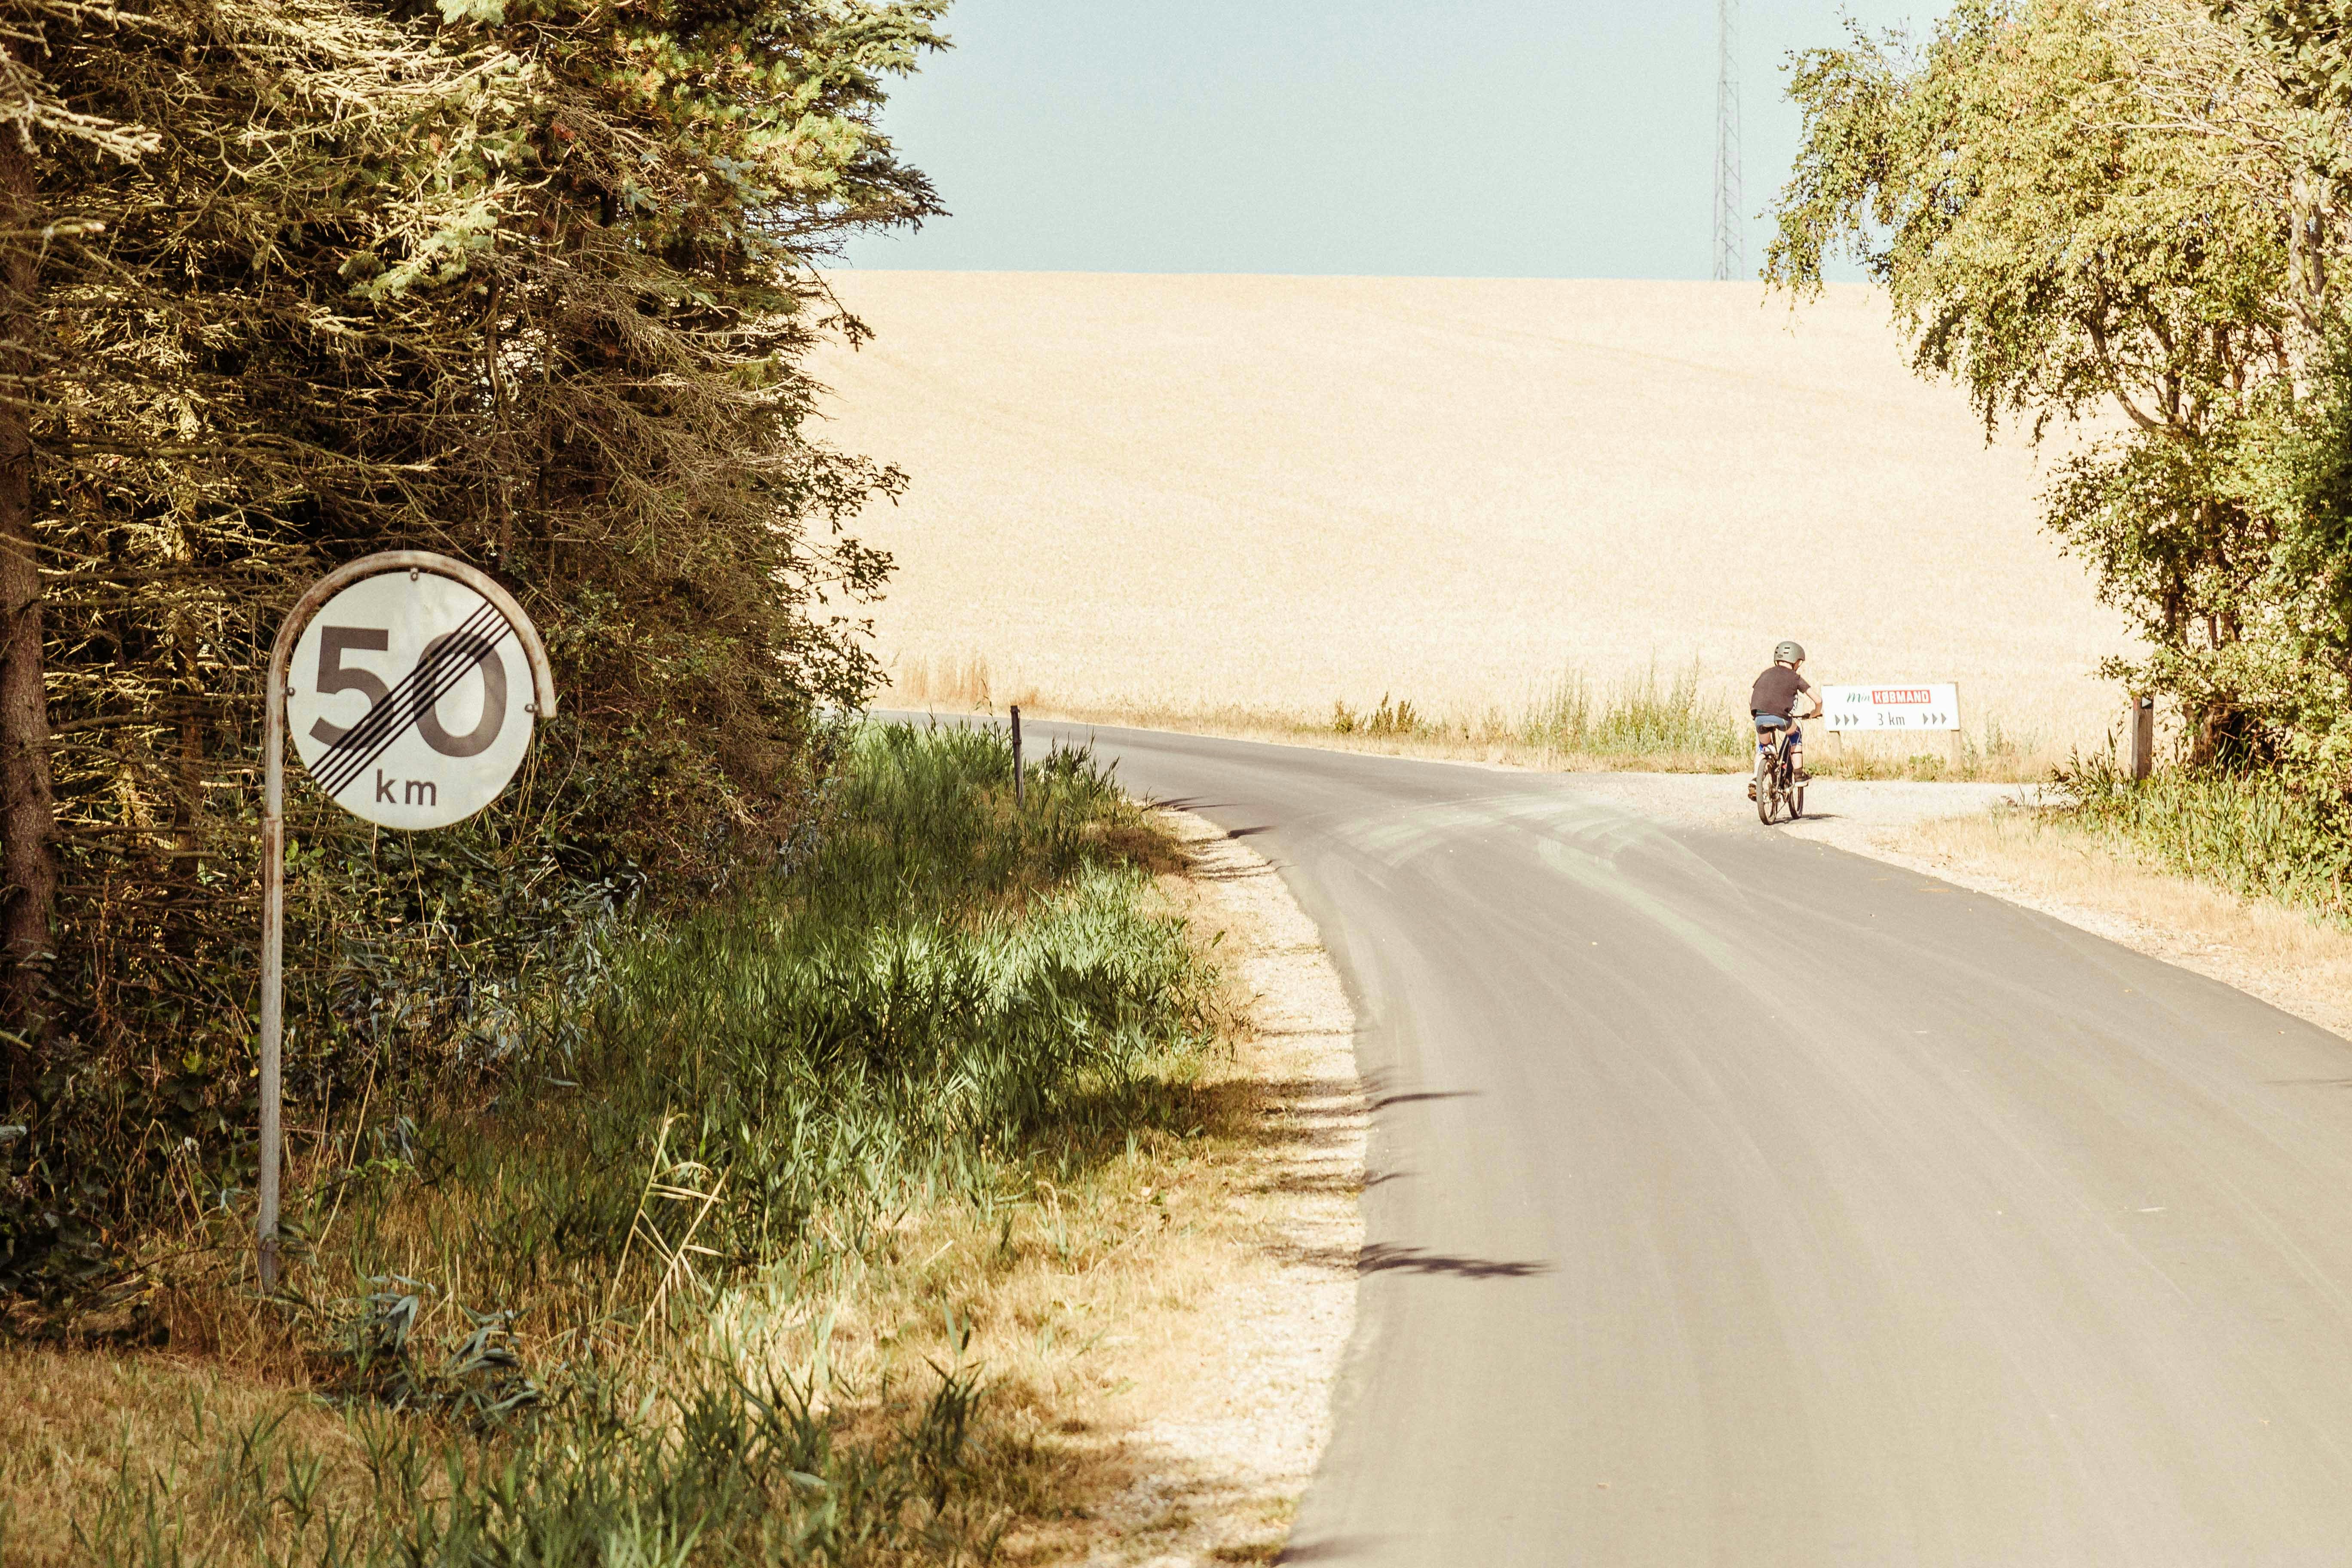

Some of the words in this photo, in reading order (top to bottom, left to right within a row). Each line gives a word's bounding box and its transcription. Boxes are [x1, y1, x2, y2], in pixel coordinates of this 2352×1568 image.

[309, 626, 506, 757] 50
[1847, 692, 1870, 703] Min
[1874, 691, 1929, 704] KØBMAND
[1878, 713, 1884, 726] 3
[1888, 712, 1905, 726] km
[376, 769, 437, 806] km
